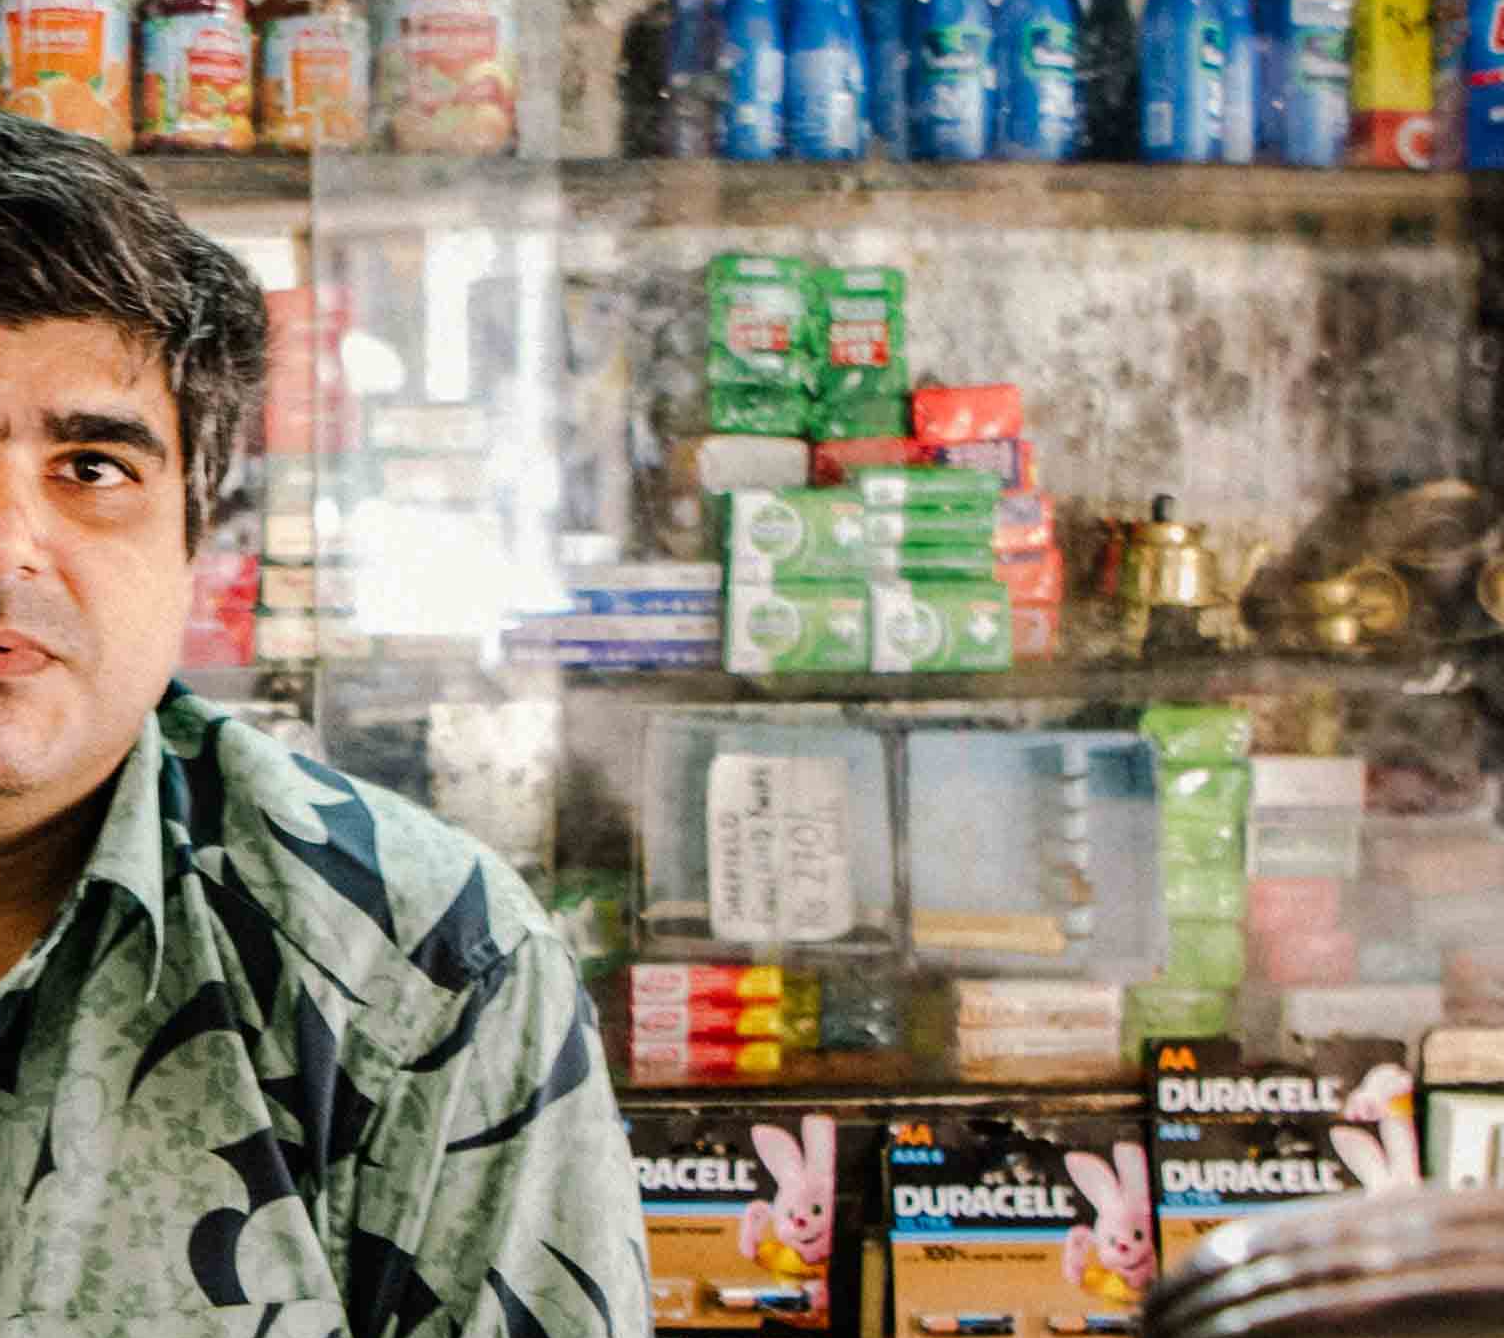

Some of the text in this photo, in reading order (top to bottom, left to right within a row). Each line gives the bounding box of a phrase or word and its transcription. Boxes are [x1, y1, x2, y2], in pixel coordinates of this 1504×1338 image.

[1157, 1046, 1198, 1073] AA
[1158, 1077, 1344, 1113] DURACELL
[894, 1123, 933, 1146] AA
[629, 1158, 757, 1192] RACELL
[1160, 1159, 1346, 1194] DURACELL
[893, 1184, 1078, 1219] DURACELL
